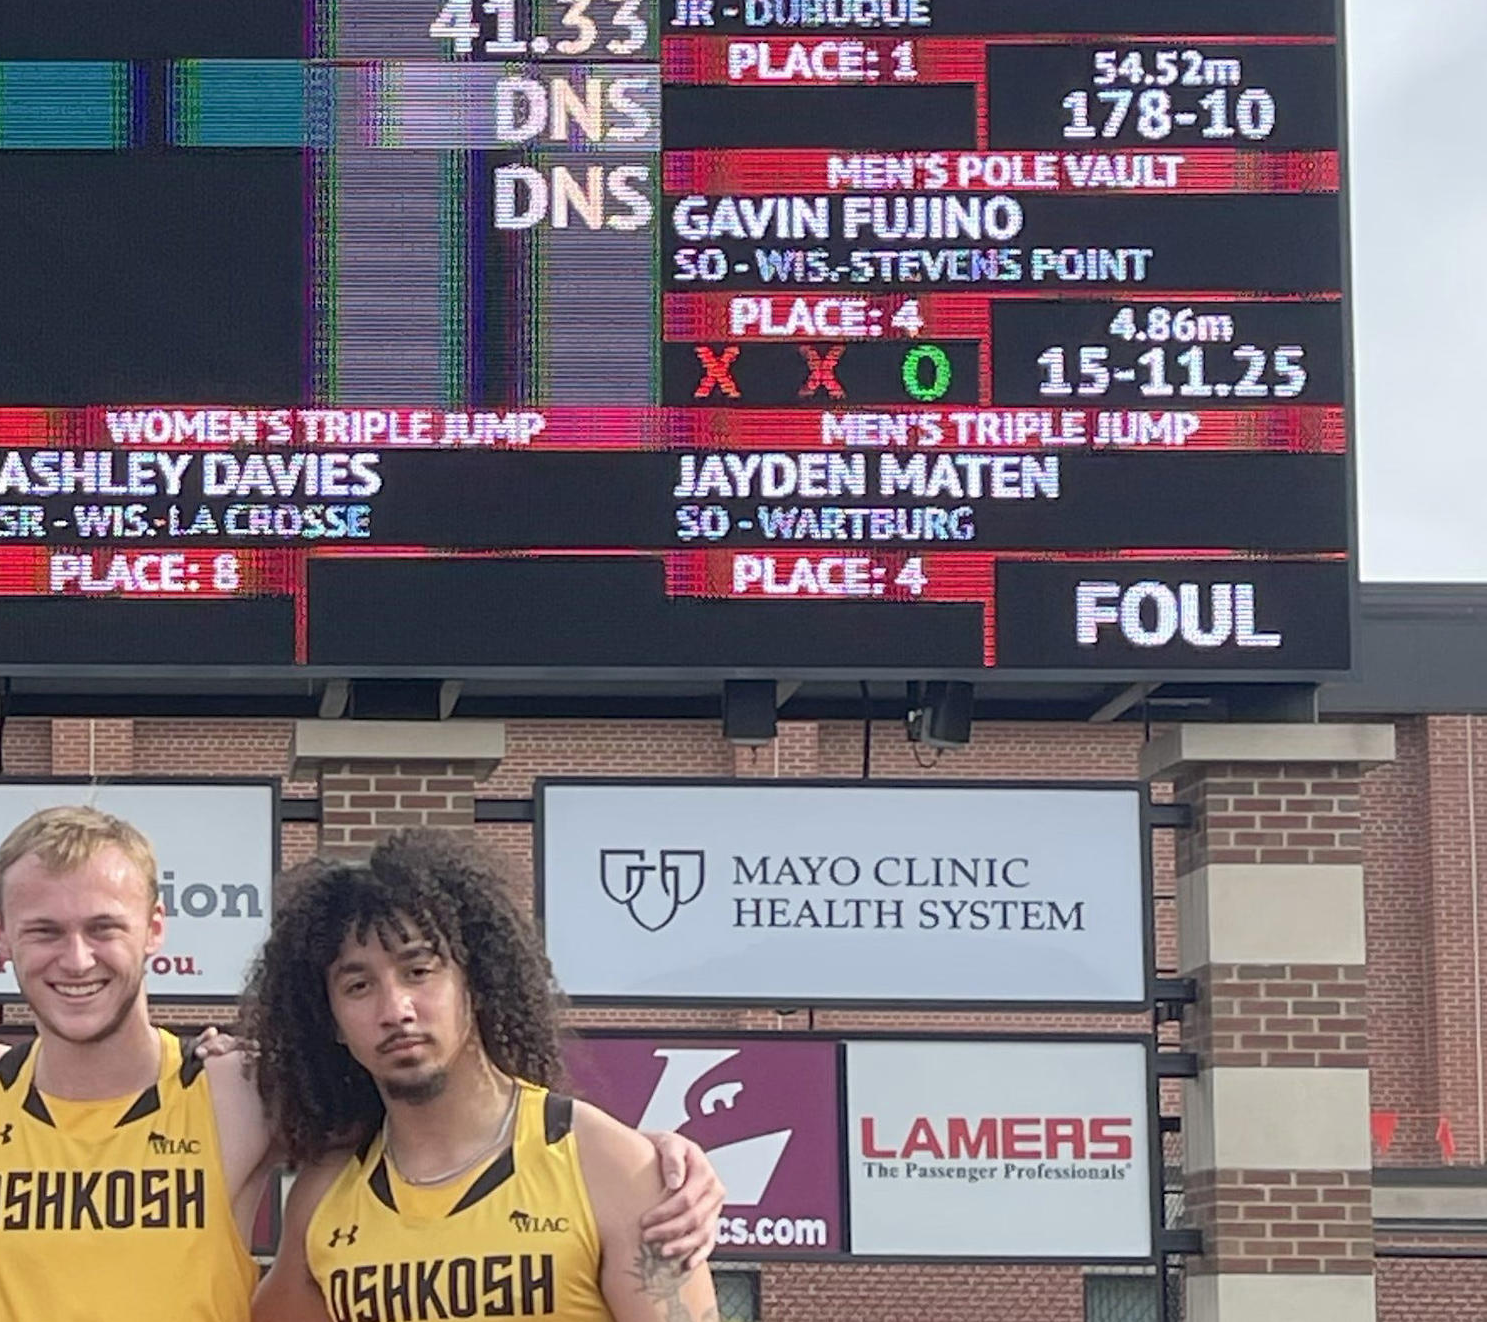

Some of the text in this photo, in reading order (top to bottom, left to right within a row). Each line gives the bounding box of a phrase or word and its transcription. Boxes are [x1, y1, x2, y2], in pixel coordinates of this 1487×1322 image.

[727, 41, 918, 81] PLACE: 1
[1093, 50, 1241, 86] 54.52m
[494, 76, 654, 143] DNS
[1061, 88, 1276, 139] 178-10
[826, 155, 1185, 190] MEN'S POLE VAULT
[494, 164, 654, 230] DNS
[671, 195, 1023, 240] GAVIN FUJINO
[673, 249, 727, 281] SO
[1031, 248, 1153, 282] POINT
[729, 297, 924, 337] PLACE: 4
[1110, 307, 1235, 342] 4.86m
[693, 345, 741, 399] X
[800, 345, 847, 399] X
[1037, 345, 1307, 397] 15-11.25
[107, 410, 546, 445] WOMEN'S TRIPLE JUMP
[821, 412, 1200, 447] MEN'S TRIPLE JUMP
[202, 452, 383, 497] DAVIES
[673, 454, 1060, 499] JAYDEN MATEN
[224, 504, 372, 538] CROSSE
[675, 506, 976, 541] SO WARTBURG
[49, 552, 240, 593] PLACE: 8
[733, 557, 928, 595] PLACE: 4
[1075, 581, 1282, 647] FOUL
[733, 855, 1031, 889] MAYO CLINIC
[159, 870, 263, 918] ion
[733, 898, 1086, 932] HEALTH SYSTEM
[150, 955, 203, 976] ou.
[861, 1116, 1133, 1160] LAMERS
[863, 1161, 899, 1179] The
[906, 1162, 998, 1183] Passenger
[715, 1216, 828, 1246] cs.com
